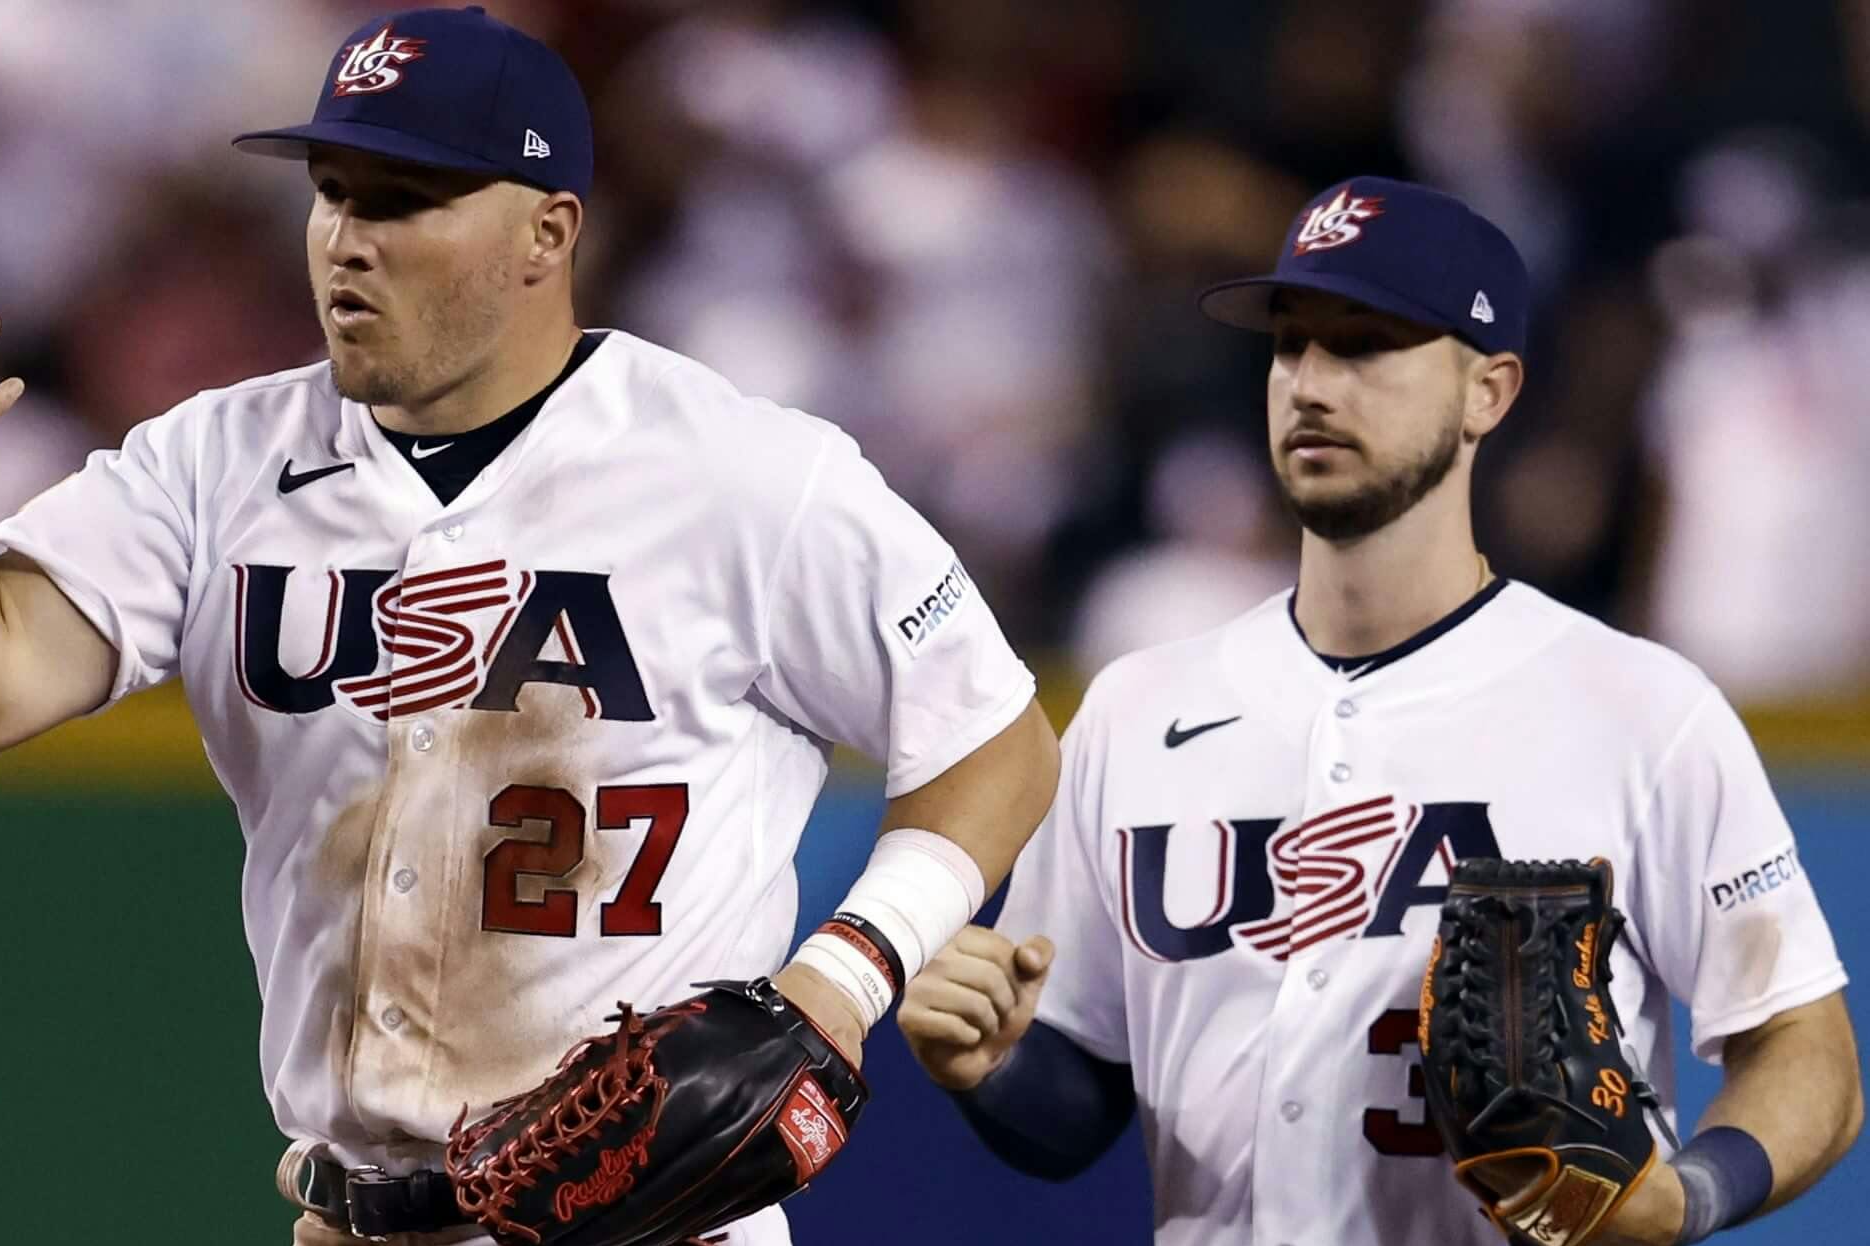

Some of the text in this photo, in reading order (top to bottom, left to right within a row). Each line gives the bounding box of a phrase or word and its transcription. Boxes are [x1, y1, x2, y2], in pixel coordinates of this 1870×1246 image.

[232, 560, 656, 722] USA
[481, 782, 689, 938] 27
[1117, 795, 1502, 964] USA
[1711, 848, 1797, 912] DIRECT
[1363, 1008, 1446, 1157] 3
[1592, 1067, 1628, 1119] 30
